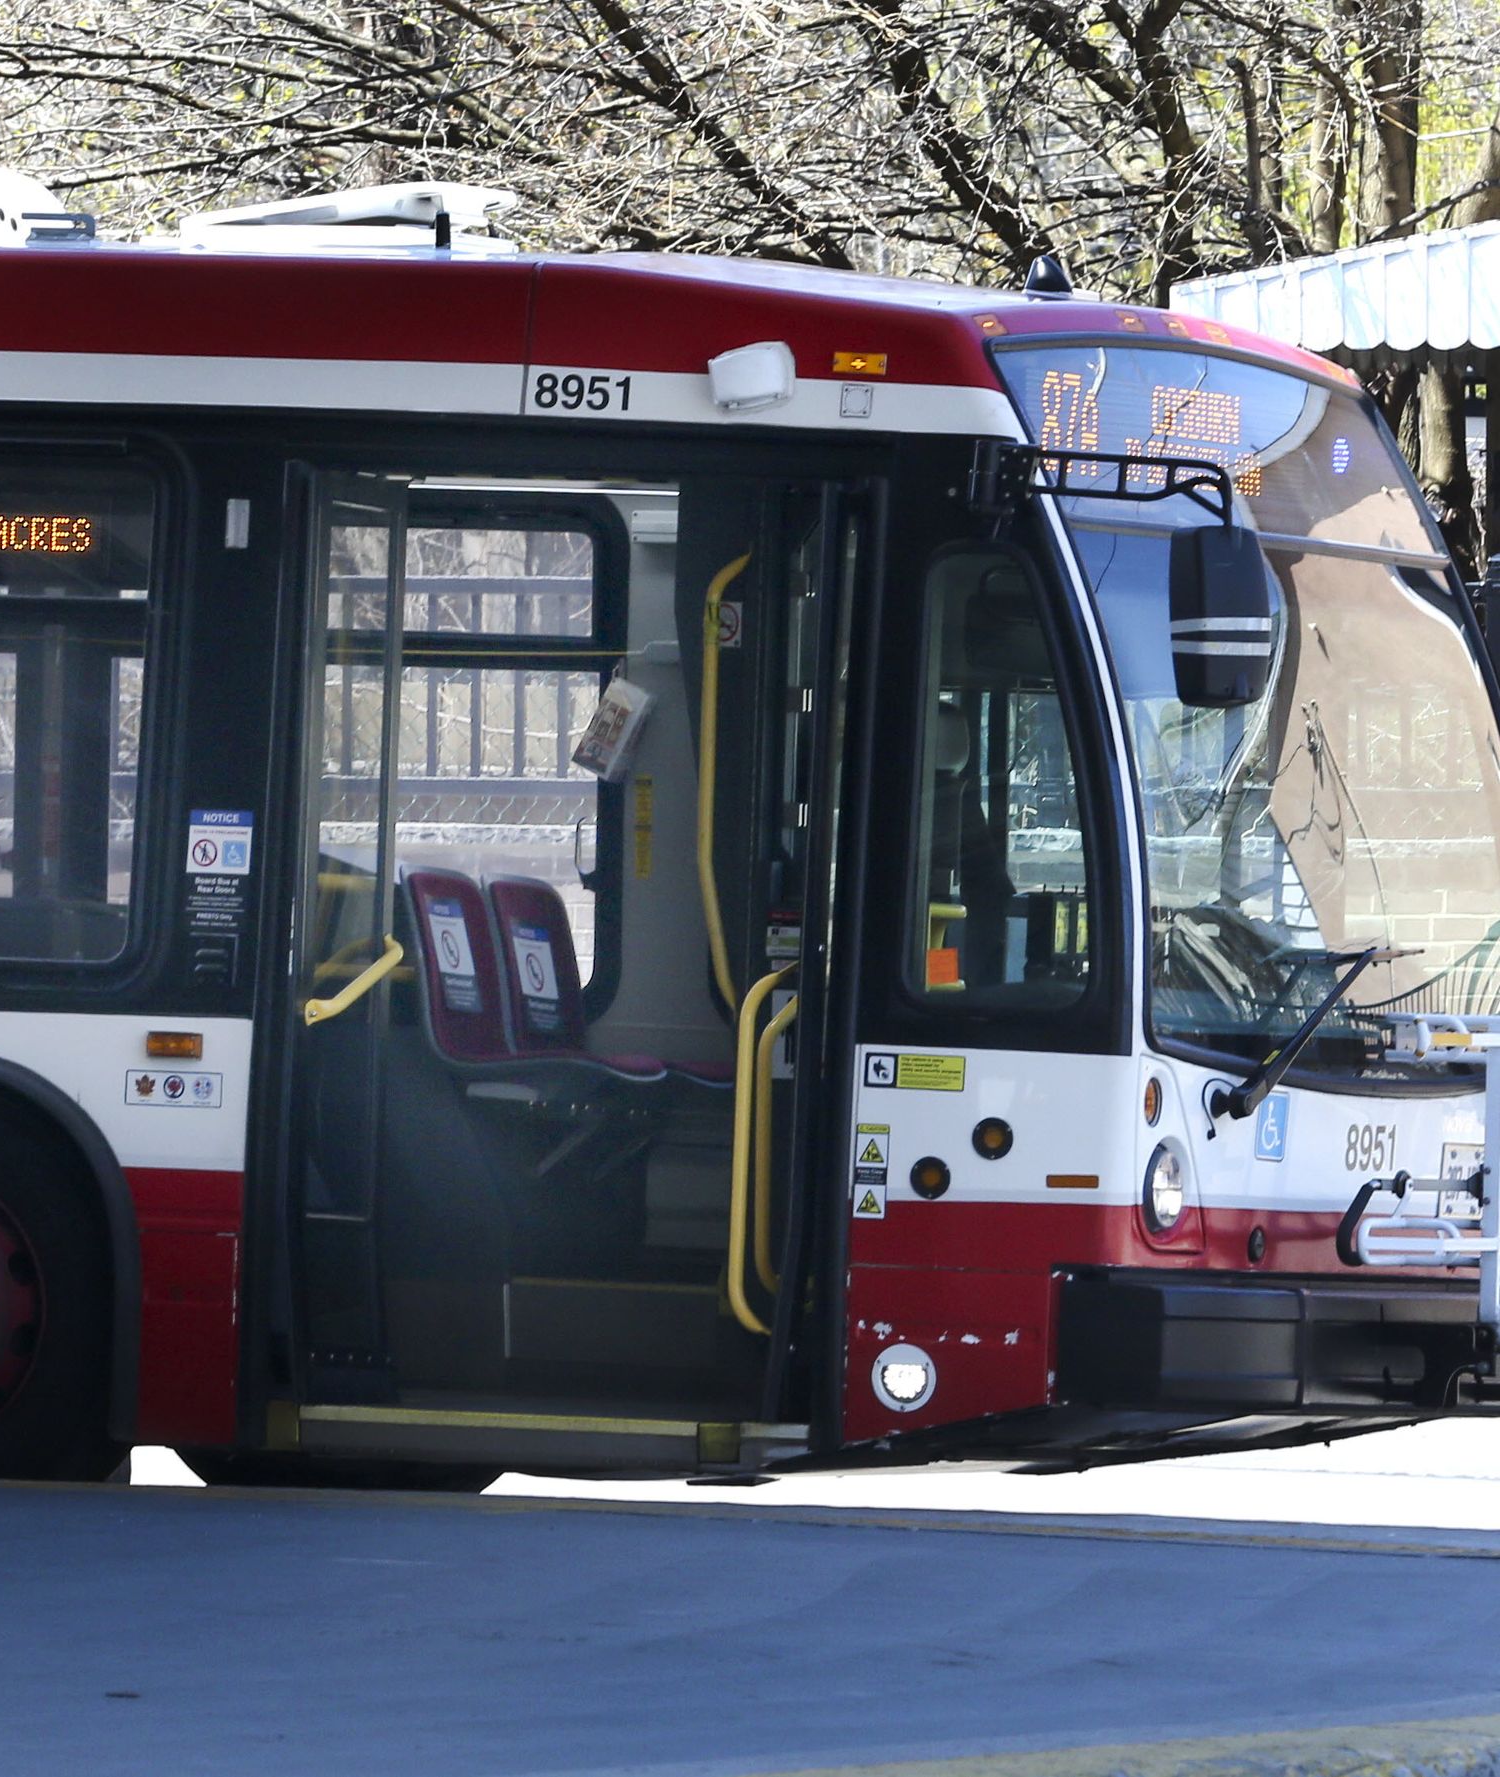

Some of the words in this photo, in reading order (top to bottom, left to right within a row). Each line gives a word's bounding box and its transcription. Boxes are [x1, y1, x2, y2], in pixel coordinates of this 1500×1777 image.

[534, 373, 631, 411] 8951
[203, 813, 240, 823] NOTICE
[1345, 1124, 1397, 1171] 8951
